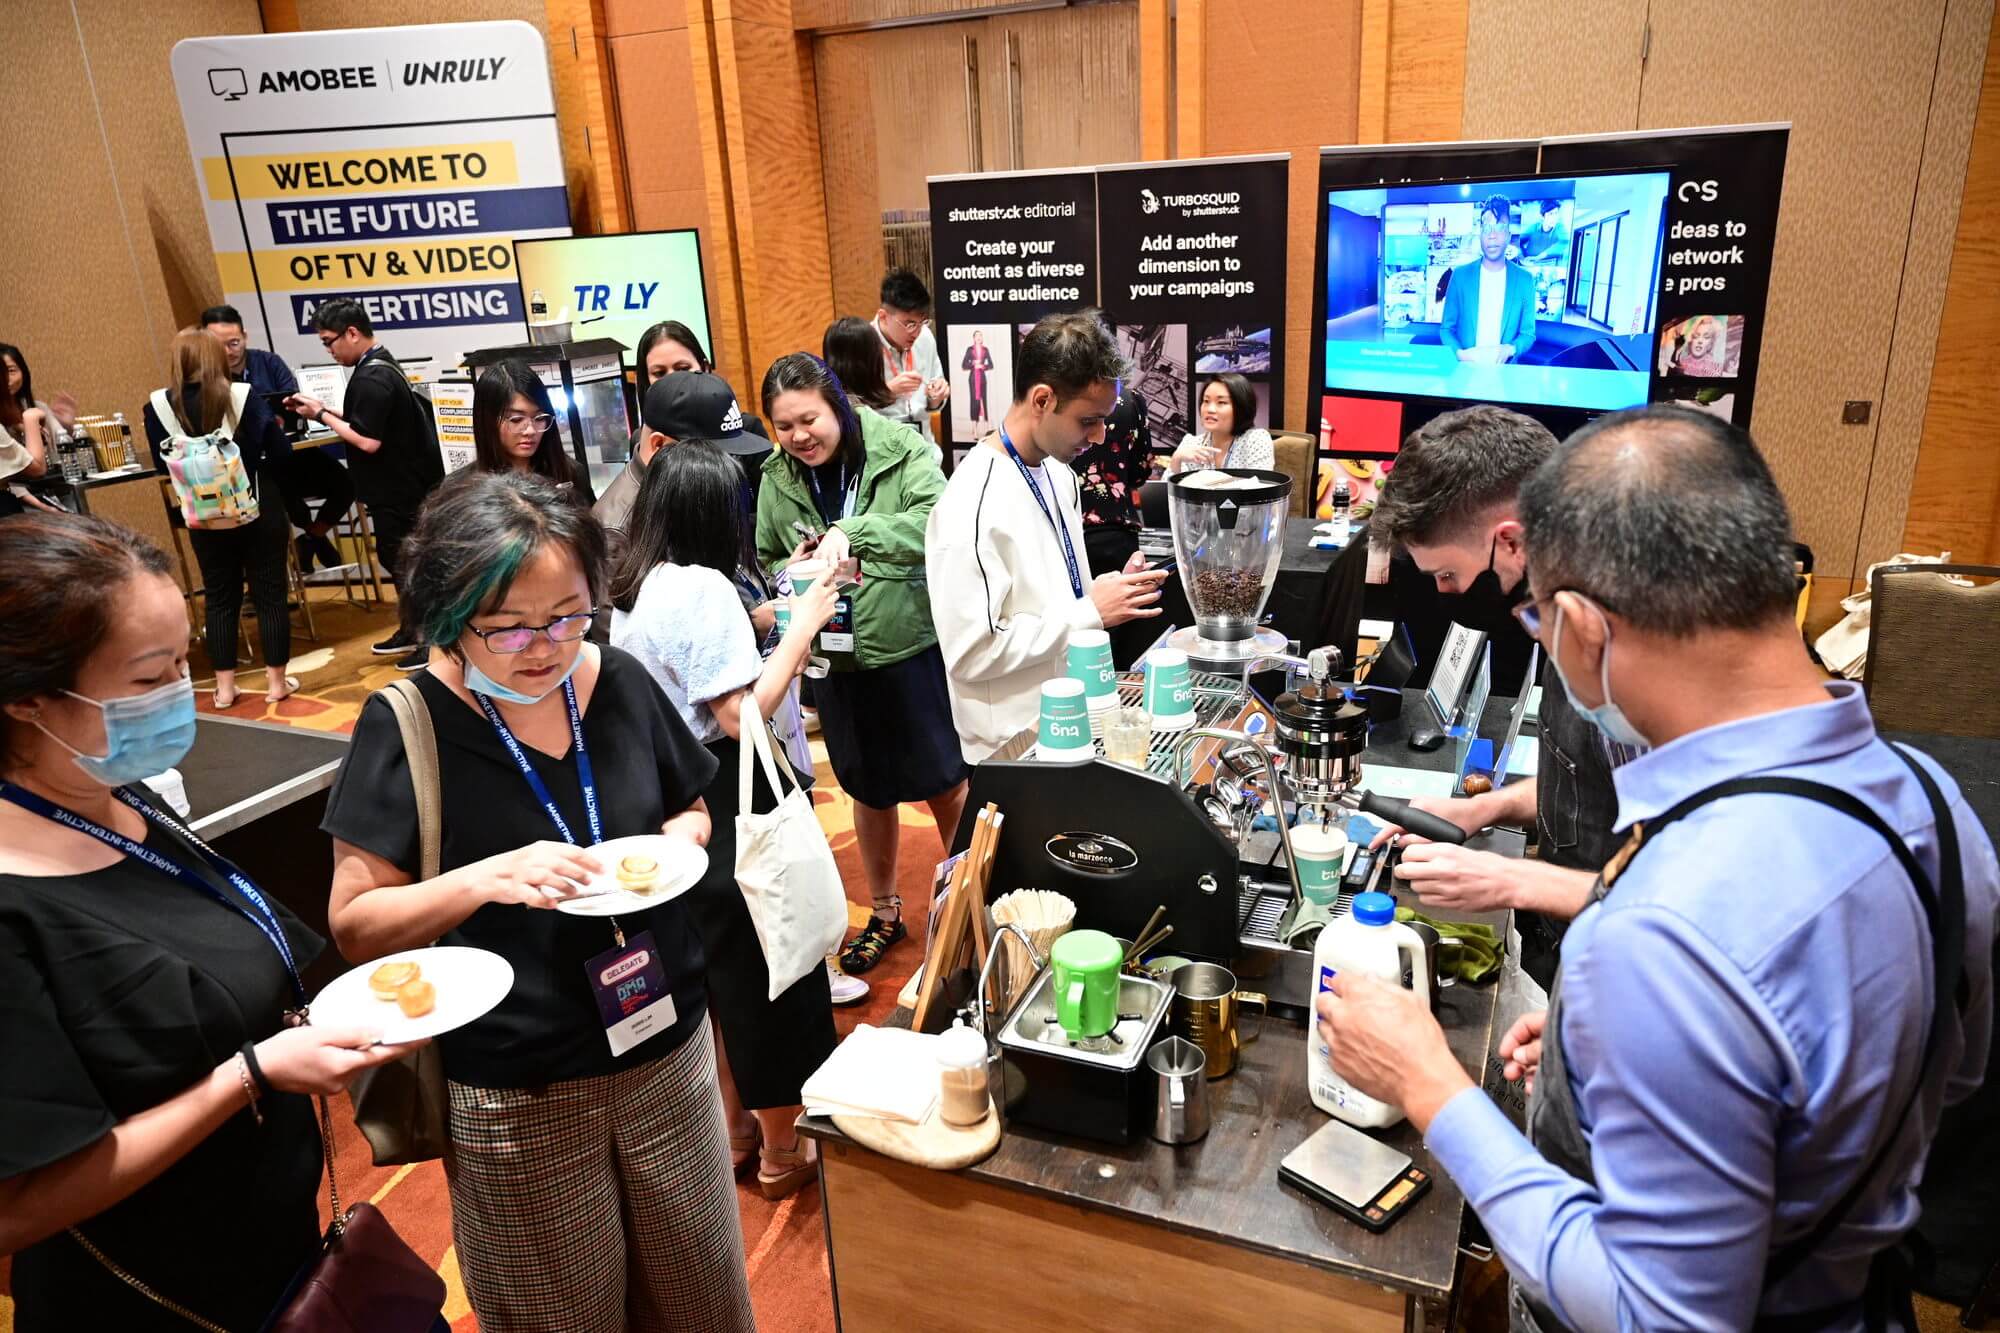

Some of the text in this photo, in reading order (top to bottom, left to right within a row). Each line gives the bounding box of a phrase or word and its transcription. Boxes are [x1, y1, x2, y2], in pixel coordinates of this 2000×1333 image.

[258, 57, 506, 94] AMOBEE UNRULY
[268, 152, 487, 190] WELCOME TO
[1162, 192, 1240, 208] TURBOSQUID
[277, 199, 479, 237] THE FUTURE
[1024, 201, 1076, 219] editorial
[1182, 207, 1192, 218] by
[1670, 220, 1747, 239] deas to
[965, 239, 1055, 258] Create your
[1141, 233, 1238, 251] Add another
[290, 244, 511, 281] OF TV & VIDEO
[1667, 245, 1744, 266] etwork
[943, 260, 1084, 279] content as diverse
[1138, 257, 1240, 274] dimension to
[950, 284, 1079, 306] as your audience
[1129, 279, 1254, 300] your campaigns
[1679, 277, 1726, 296] pros
[301, 289, 509, 327] AERTISING
[1050, 724, 1080, 737] tug
[1069, 849, 1076, 858] la
[1077, 852, 1113, 864] marzocco
[606, 955, 643, 980] DELEGATE
